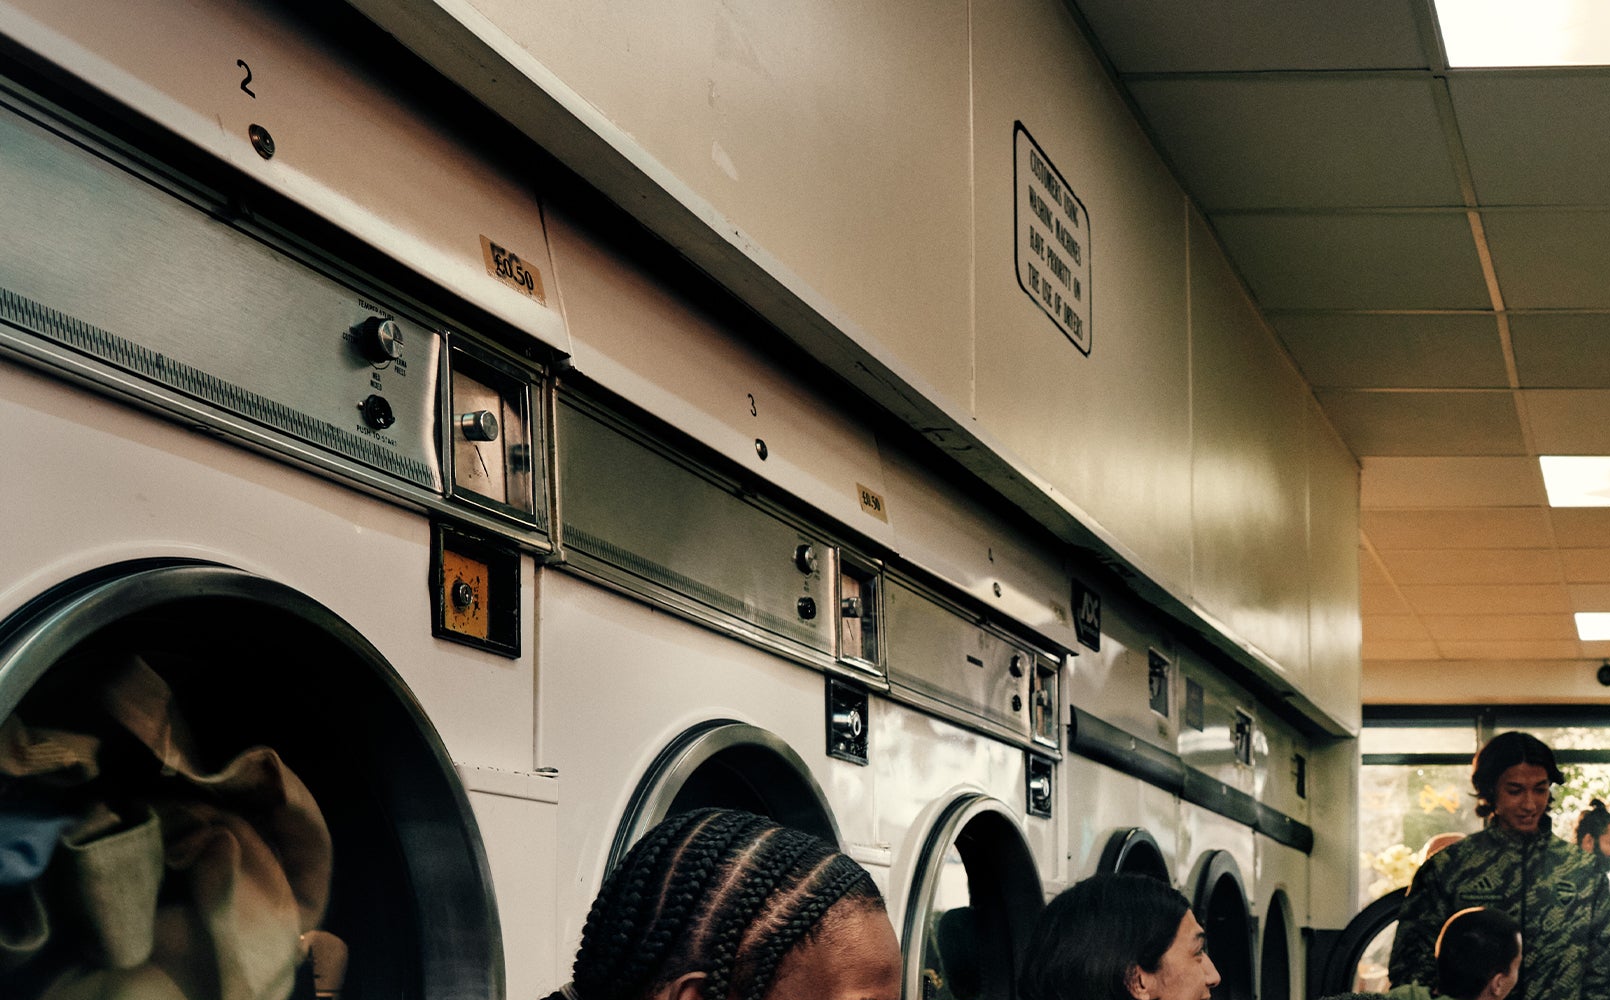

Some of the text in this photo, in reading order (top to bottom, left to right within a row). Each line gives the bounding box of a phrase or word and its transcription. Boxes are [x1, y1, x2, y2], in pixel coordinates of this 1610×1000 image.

[236, 59, 256, 99] 2
[1031, 150, 1079, 228] CUSTOMERS USING
[1028, 185, 1081, 267] WASHING MACHINES
[1030, 225, 1045, 261] HAVE
[1047, 245, 1071, 291] PRIORITY
[1028, 262, 1083, 341] THE USE OF DRYERS
[747, 393, 757, 417] 3
[372, 431, 381, 440] TO
[862, 490, 881, 511] £0.50
